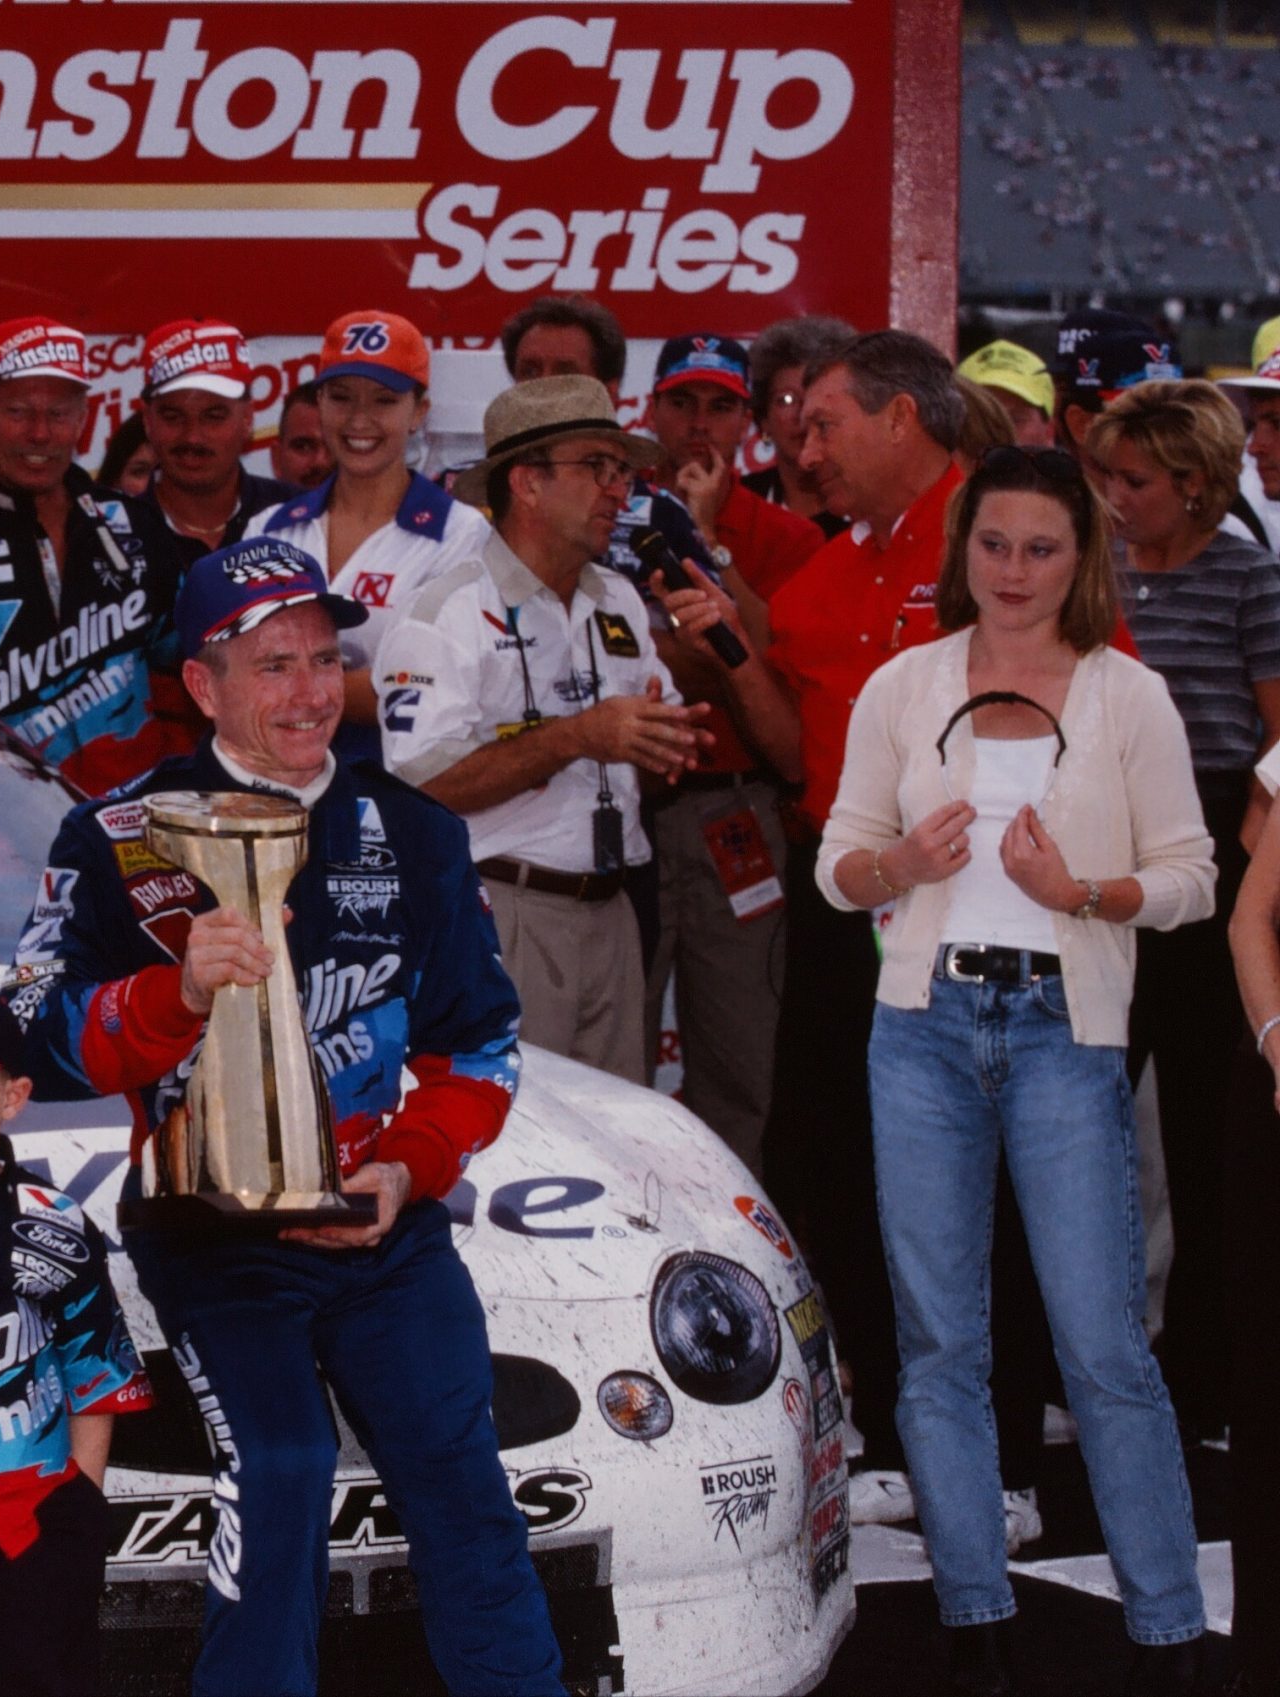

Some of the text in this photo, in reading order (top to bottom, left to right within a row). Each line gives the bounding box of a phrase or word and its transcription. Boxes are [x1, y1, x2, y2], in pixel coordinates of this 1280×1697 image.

[454, 16, 856, 193] Cup
[409, 183, 806, 294] Series
[342, 322, 391, 355] 76
[147, 340, 229, 384] Winston
[129, 872, 196, 914] BUGLES
[340, 880, 400, 894] ROUSH
[27, 1224, 78, 1256] Ford
[717, 1464, 776, 1494] ROUSH
